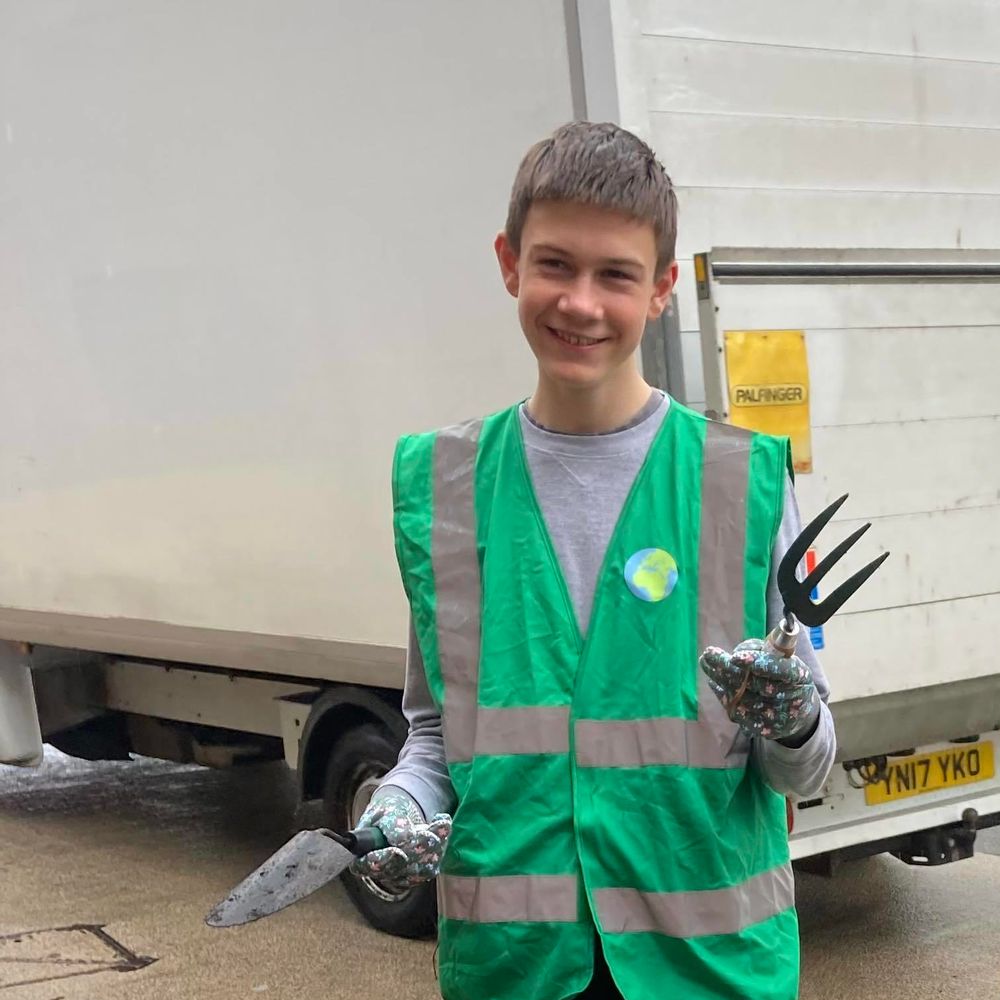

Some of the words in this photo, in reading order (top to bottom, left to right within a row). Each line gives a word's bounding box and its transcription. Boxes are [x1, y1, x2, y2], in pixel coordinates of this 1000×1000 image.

[735, 387, 803, 403] PALFINGER
[882, 758, 931, 796] YN17
[938, 748, 981, 783] YKO
